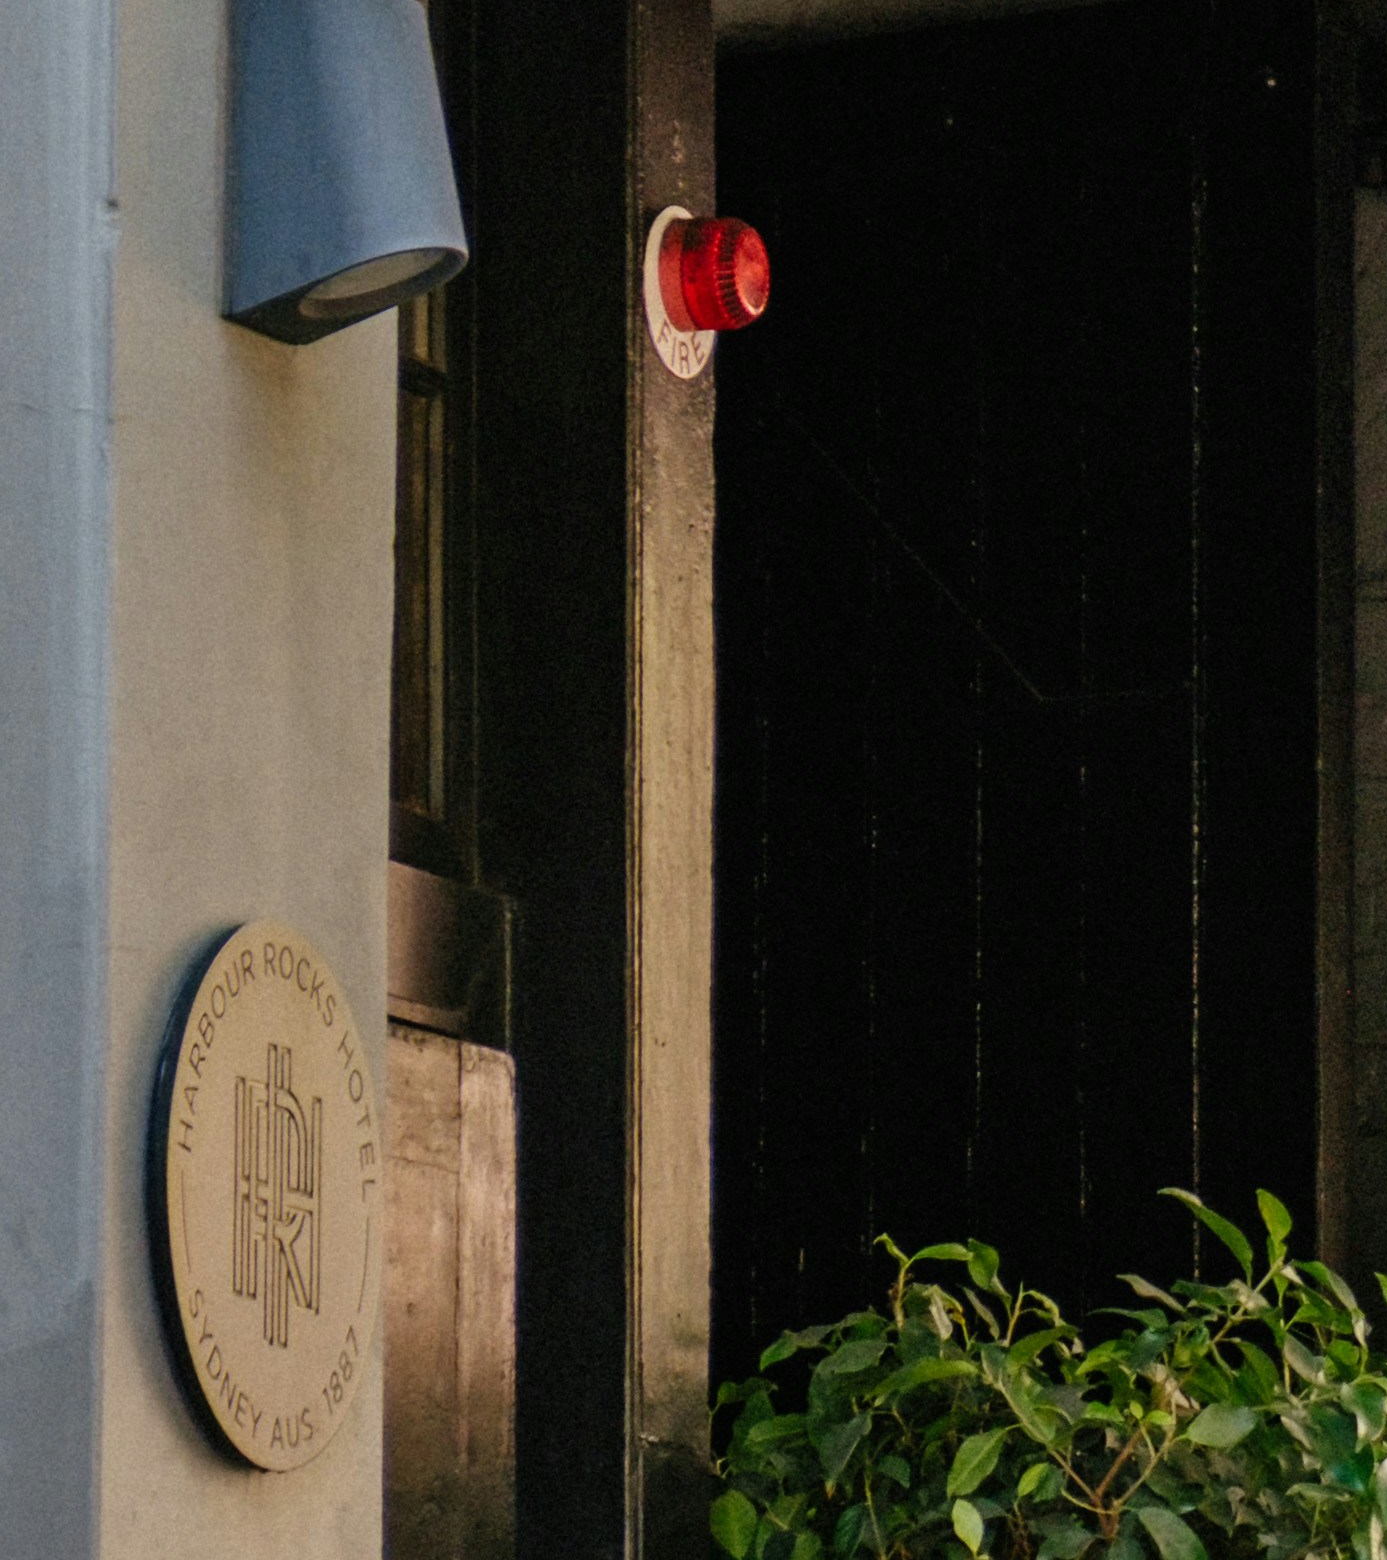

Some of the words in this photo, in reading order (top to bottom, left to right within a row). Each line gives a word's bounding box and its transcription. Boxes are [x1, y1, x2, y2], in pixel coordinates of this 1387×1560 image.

[656, 319, 705, 374] FIRE
[178, 949, 255, 1153] HARBOUR
[264, 943, 336, 1027] ROCKS
[337, 1031, 376, 1202] HOTEL
[189, 1289, 262, 1438] SYDNEY
[322, 1325, 359, 1416] 1887
